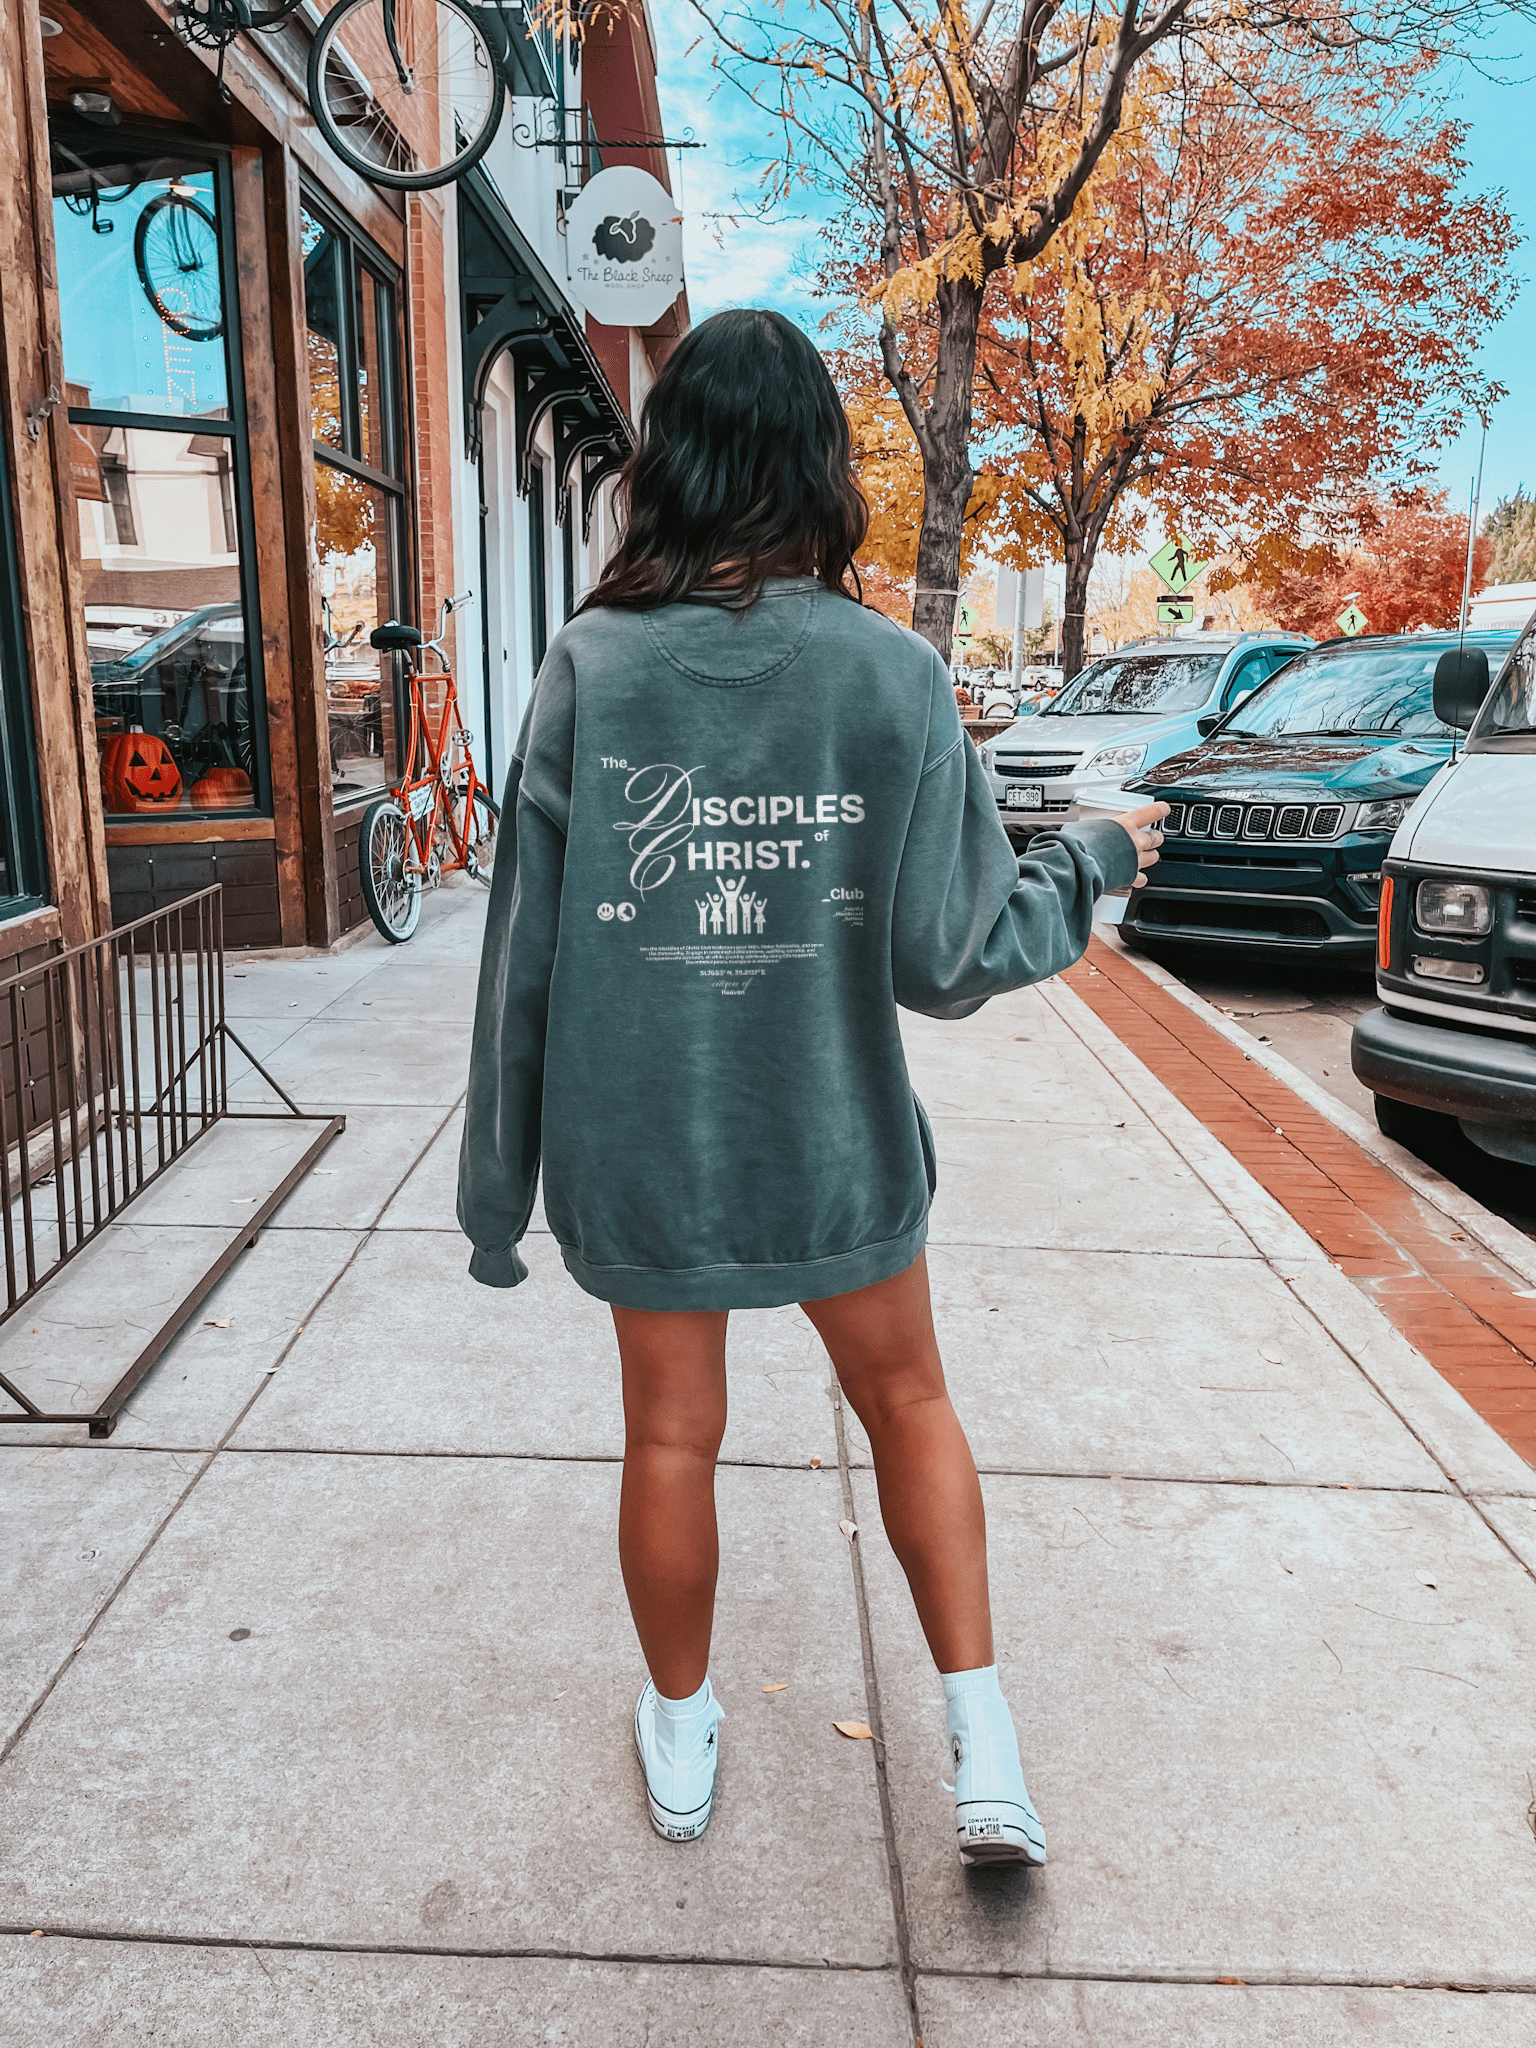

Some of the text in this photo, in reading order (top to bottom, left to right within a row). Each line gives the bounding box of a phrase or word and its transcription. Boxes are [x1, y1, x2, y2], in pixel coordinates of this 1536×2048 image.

[577, 267, 673, 285] The Black Sheep
[156, 287, 196, 406] OPEN
[1221, 790, 1251, 800] Jeep
[814, 829, 830, 842] of
